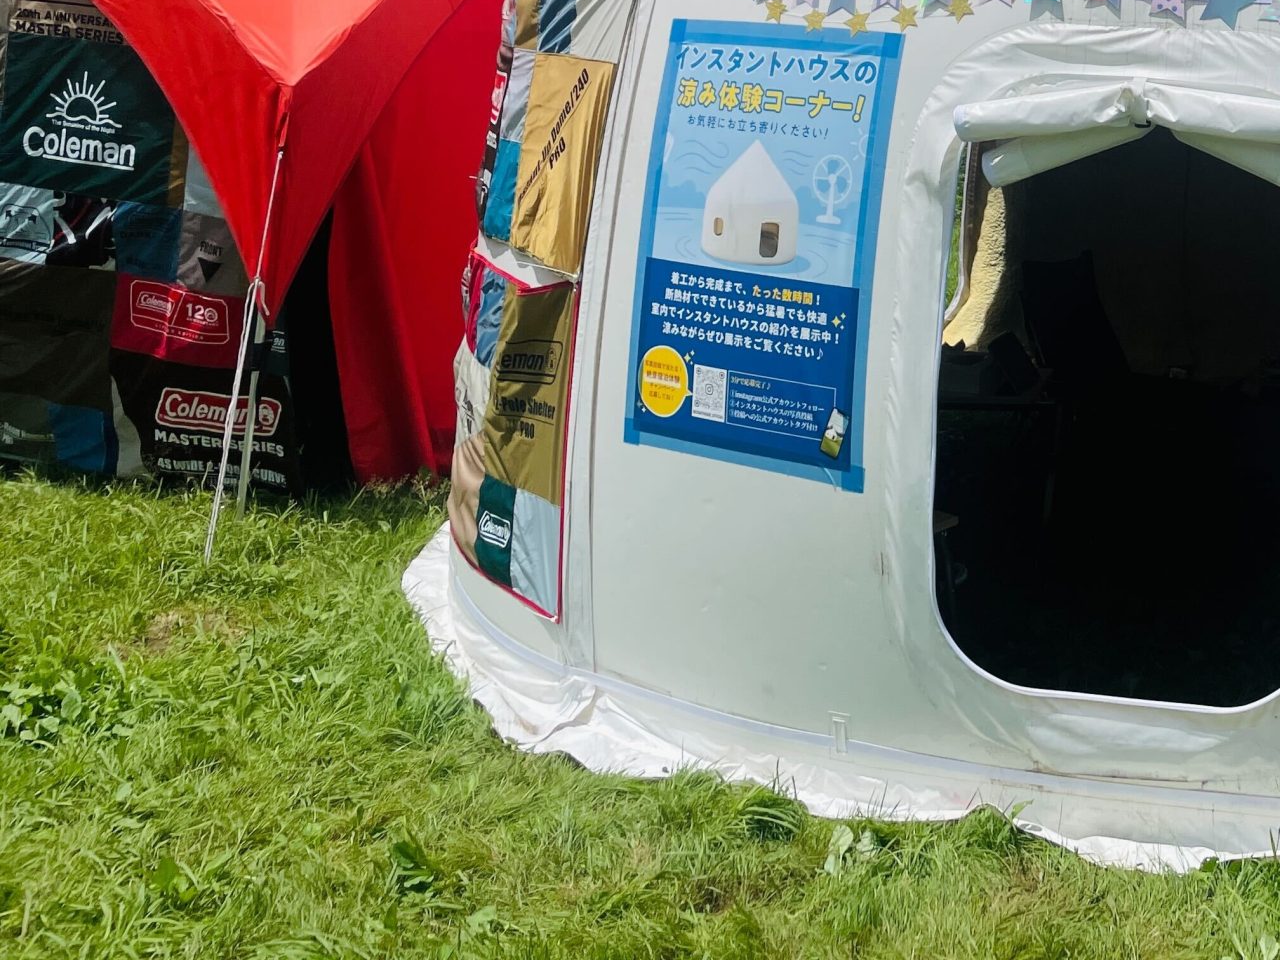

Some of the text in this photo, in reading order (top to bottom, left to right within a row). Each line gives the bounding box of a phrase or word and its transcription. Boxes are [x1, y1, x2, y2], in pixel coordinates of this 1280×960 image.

[16, 21, 124, 45] MASTER SERIES
[676, 45, 878, 85] インスタントハウスの
[677, 77, 866, 123] 涼み体験コーナー!
[22, 126, 136, 167] Coleman
[154, 429, 222, 449] MASTER
